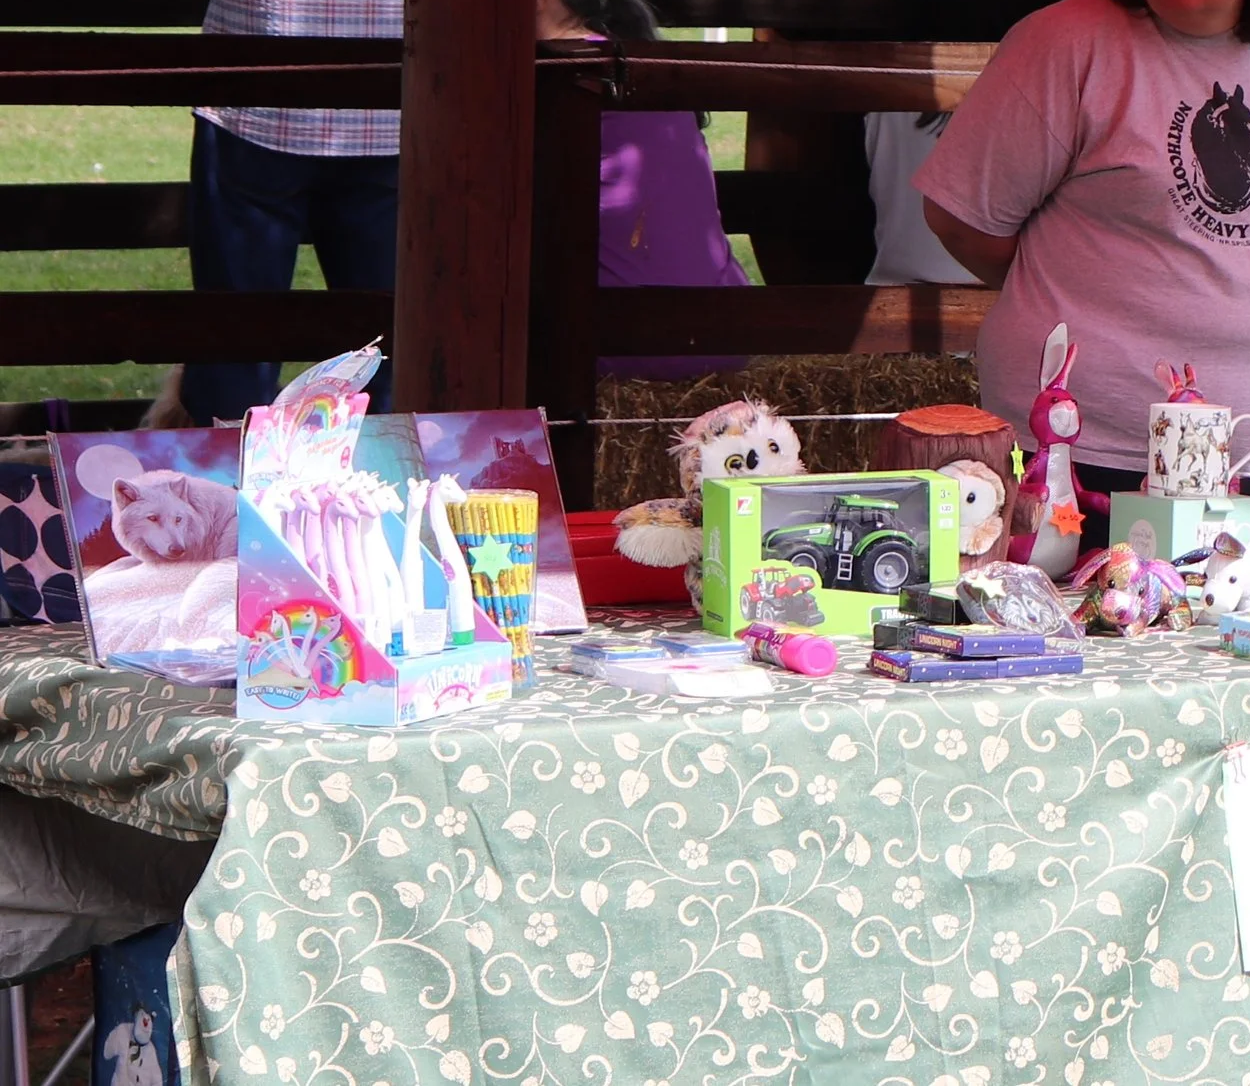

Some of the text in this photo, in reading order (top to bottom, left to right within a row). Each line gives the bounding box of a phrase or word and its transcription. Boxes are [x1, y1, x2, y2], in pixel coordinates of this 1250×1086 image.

[1167, 100, 1198, 206] NORTHCOTE
[1191, 206, 1250, 239] HEAVY
[246, 687, 264, 695] EASY
